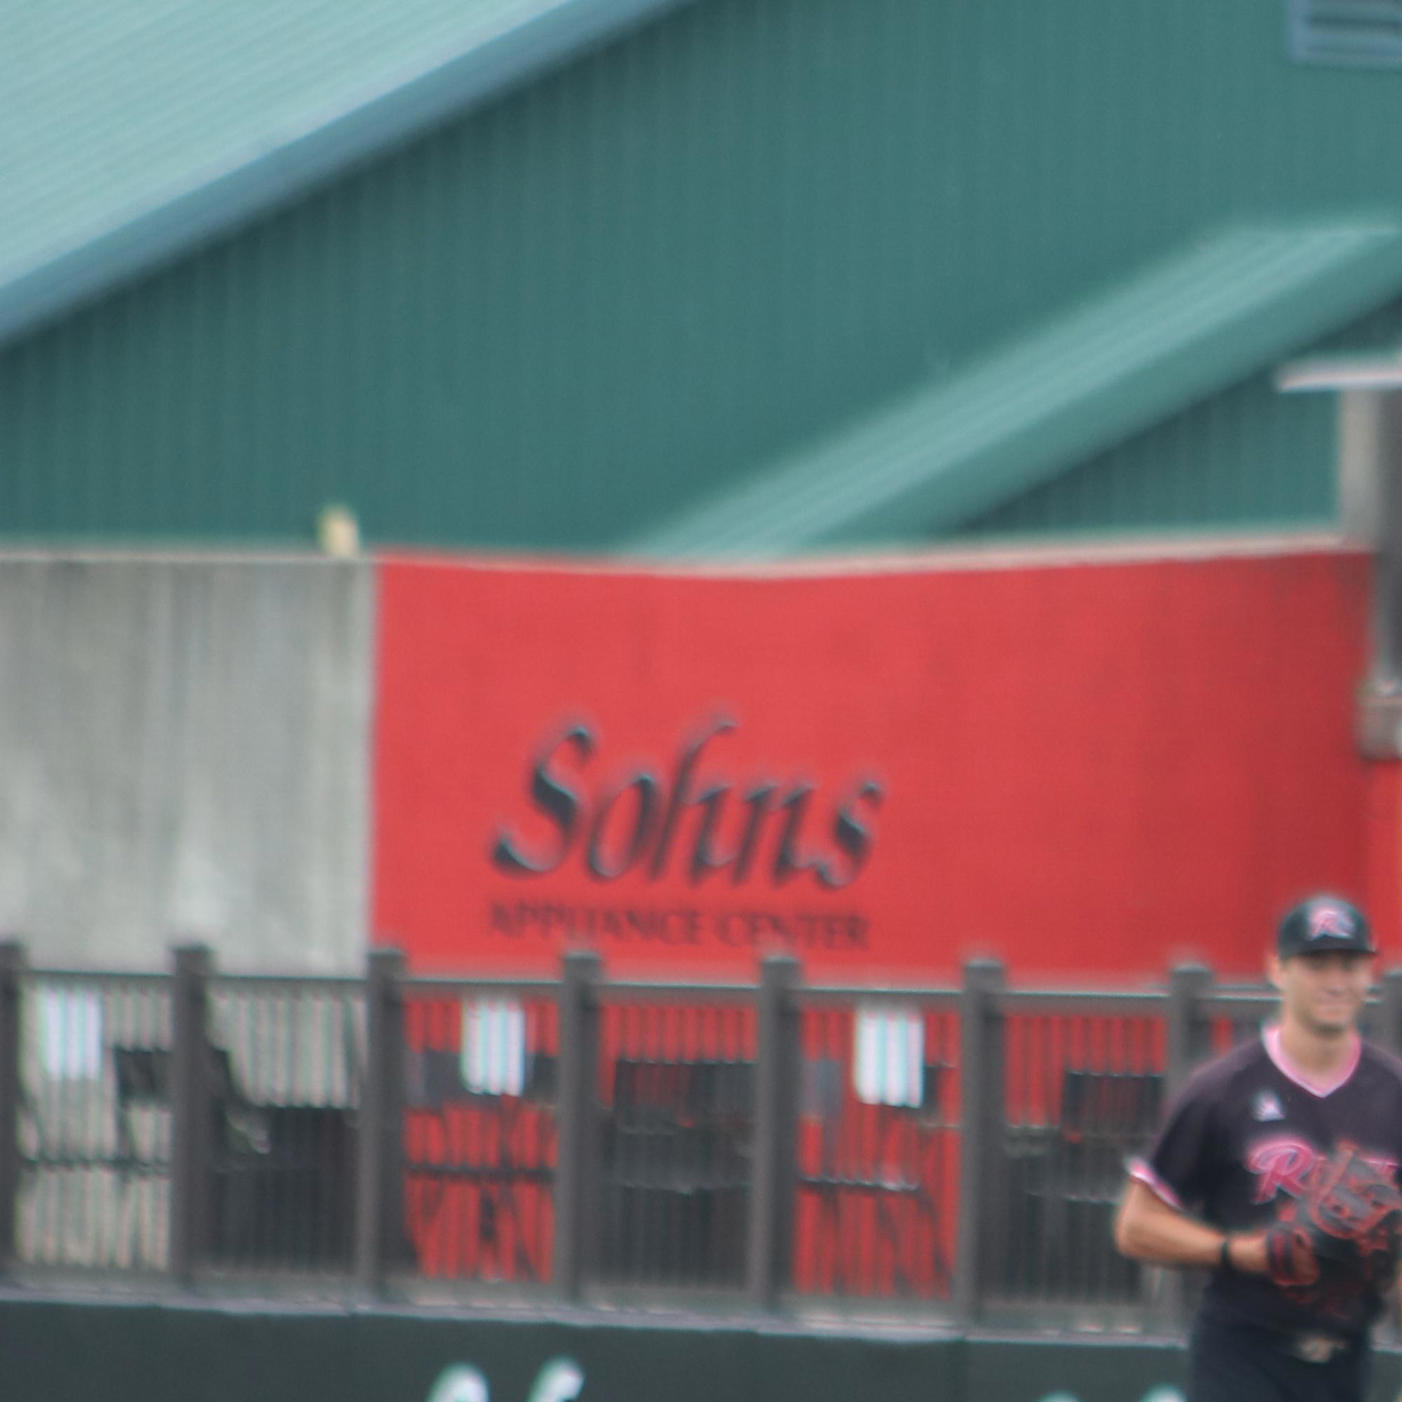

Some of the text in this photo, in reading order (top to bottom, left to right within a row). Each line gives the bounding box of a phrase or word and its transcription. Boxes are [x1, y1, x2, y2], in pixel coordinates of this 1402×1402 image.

[491, 712, 886, 889] Sohns
[489, 898, 871, 949] APPLIANCE CENTER
